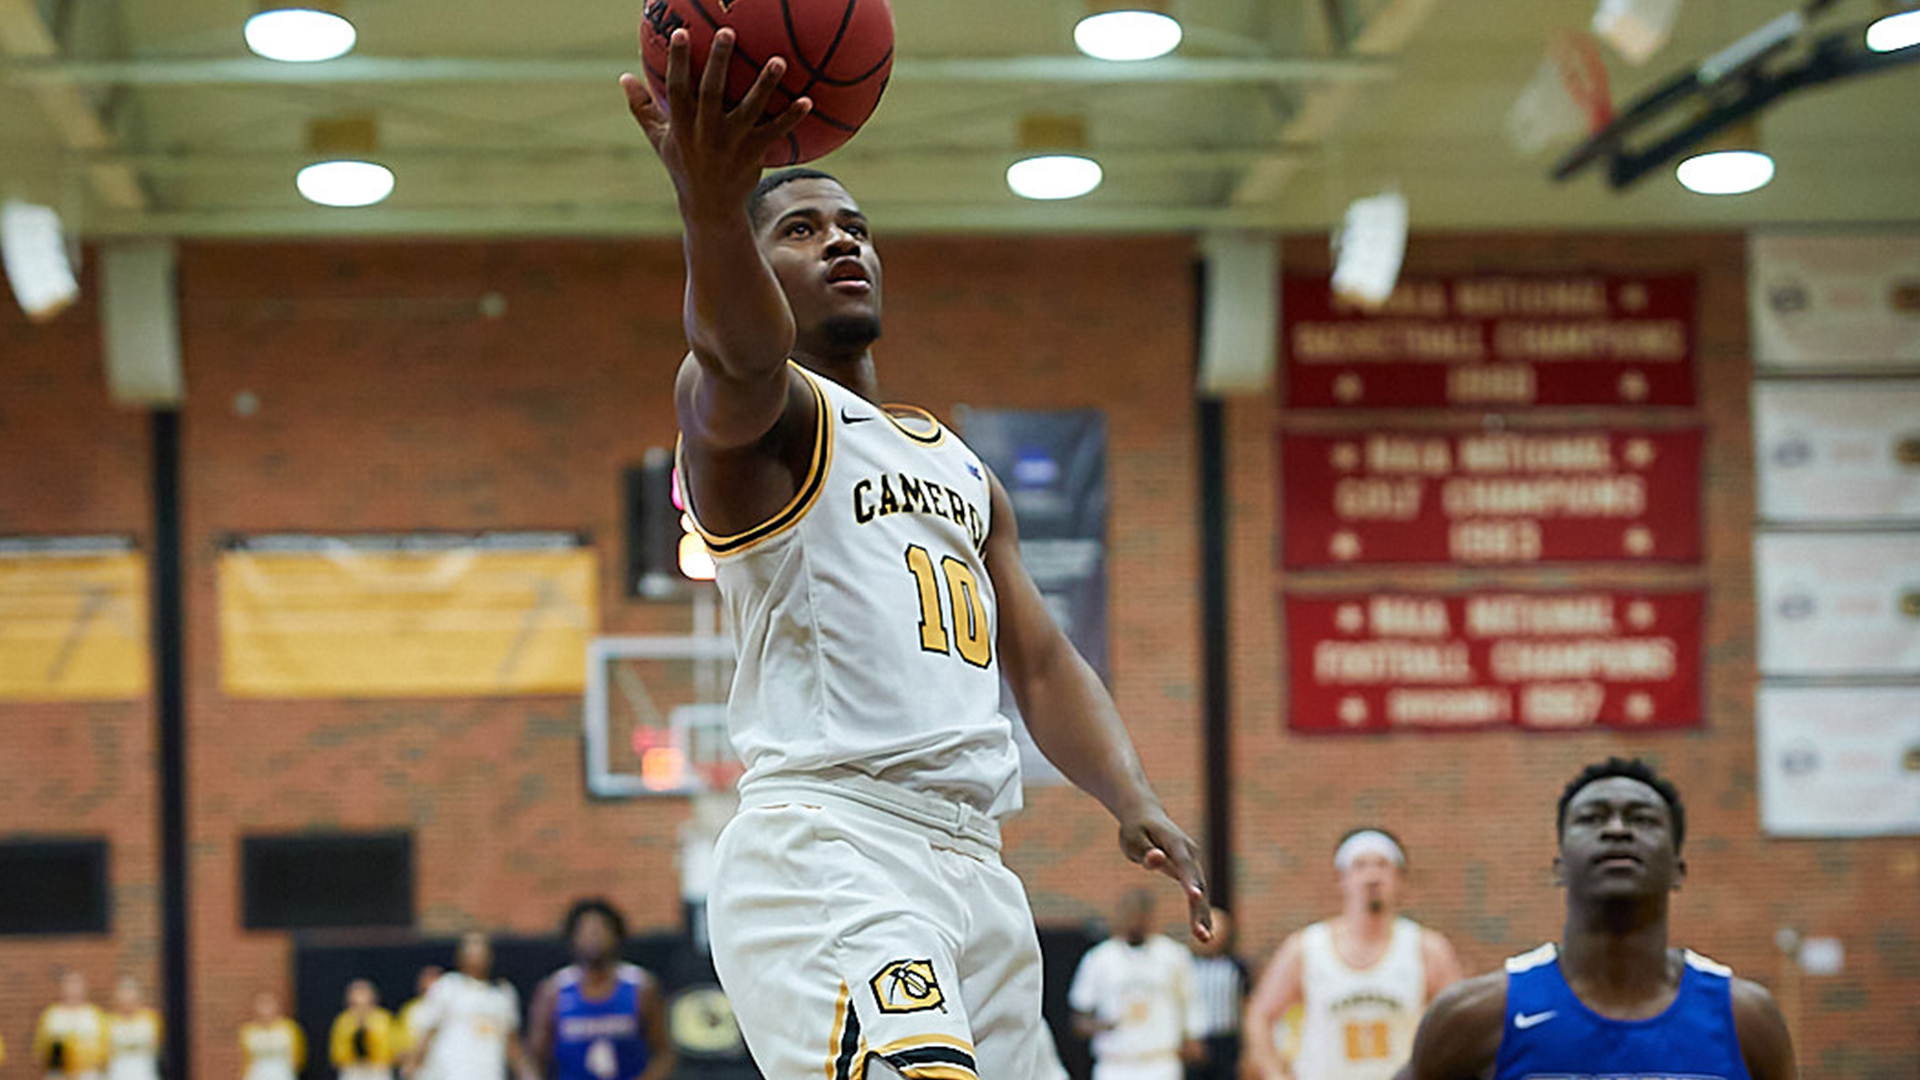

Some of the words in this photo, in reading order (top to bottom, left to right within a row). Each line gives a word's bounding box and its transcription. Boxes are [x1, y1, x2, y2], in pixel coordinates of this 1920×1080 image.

[1458, 436, 1613, 473] NATIONAL
[854, 472, 986, 556] CAMERO
[1443, 475, 1648, 517] CHAMPIONS
[905, 544, 993, 669] 10
[1464, 596, 1616, 638] NATIONAL
[1490, 636, 1677, 682] CHAMPIONS
